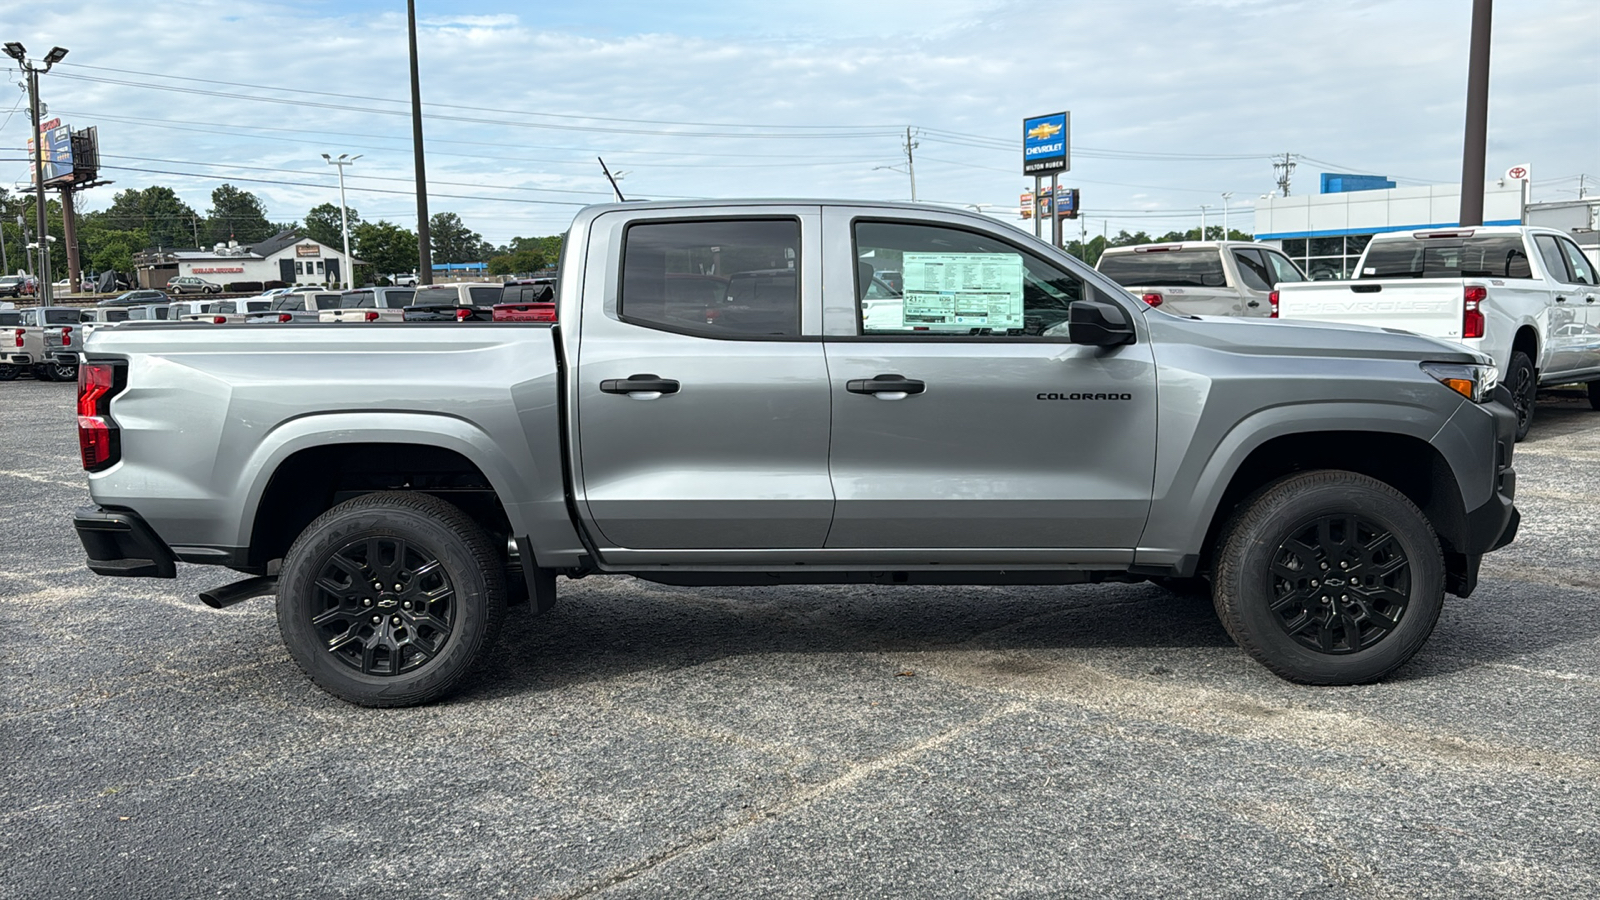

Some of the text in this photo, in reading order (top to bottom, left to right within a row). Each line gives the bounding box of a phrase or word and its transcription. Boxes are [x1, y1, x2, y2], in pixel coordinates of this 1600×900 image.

[1026, 143, 1063, 156] CHEVROLET
[1025, 160, 1064, 171] MILTON RUBEN
[1288, 300, 1450, 314] CHEVROLET
[1036, 393, 1132, 401] COLORADO
